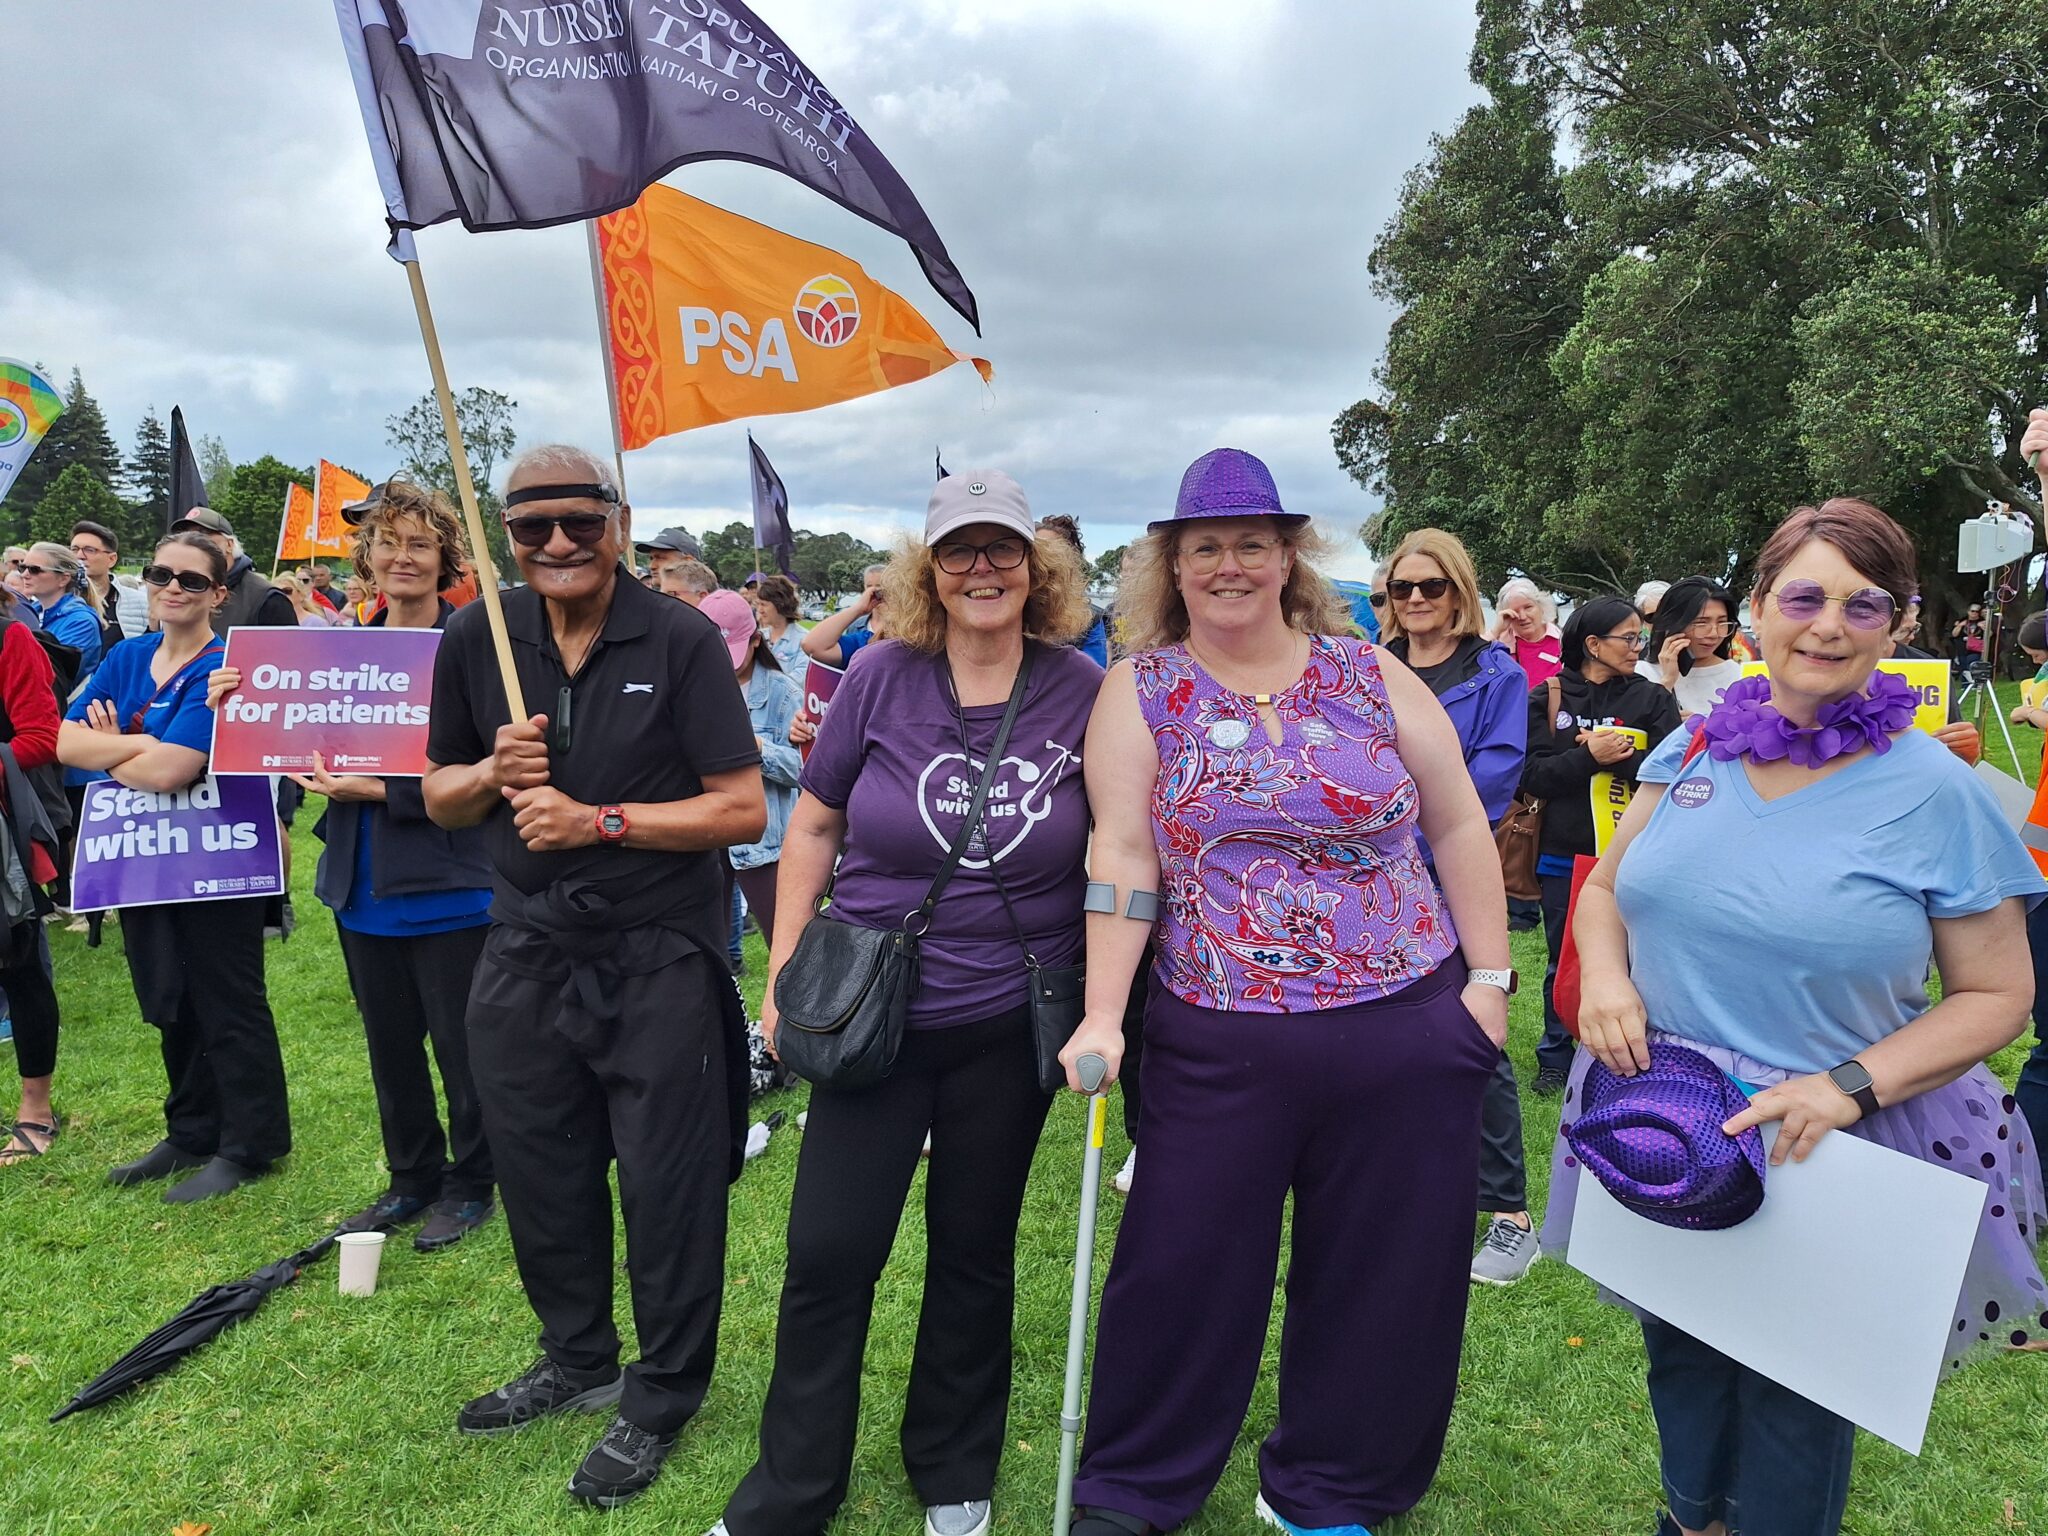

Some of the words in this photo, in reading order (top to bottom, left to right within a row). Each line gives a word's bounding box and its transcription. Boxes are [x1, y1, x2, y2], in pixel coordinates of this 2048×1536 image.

[489, 0, 624, 47] NURSES
[486, 47, 632, 80] ORGANISATION
[647, 5, 855, 155] TAPUHI
[665, 0, 856, 128] OPŪTANGA
[640, 55, 718, 97] KAITIAKI
[722, 89, 740, 102] O
[742, 96, 838, 175] AOTEAROA
[679, 306, 799, 382] PSA
[252, 664, 301, 690] On
[308, 663, 410, 692] strike
[224, 695, 278, 723] for
[283, 696, 430, 730] patients
[89, 774, 221, 822] Stand
[936, 797, 984, 818] wit
[990, 804, 1017, 817] us
[1674, 788, 1710, 799] STRIKE
[1679, 783, 1695, 791] I'M
[1696, 784, 1711, 792] ON
[84, 818, 189, 863] with
[202, 822, 259, 852] us
